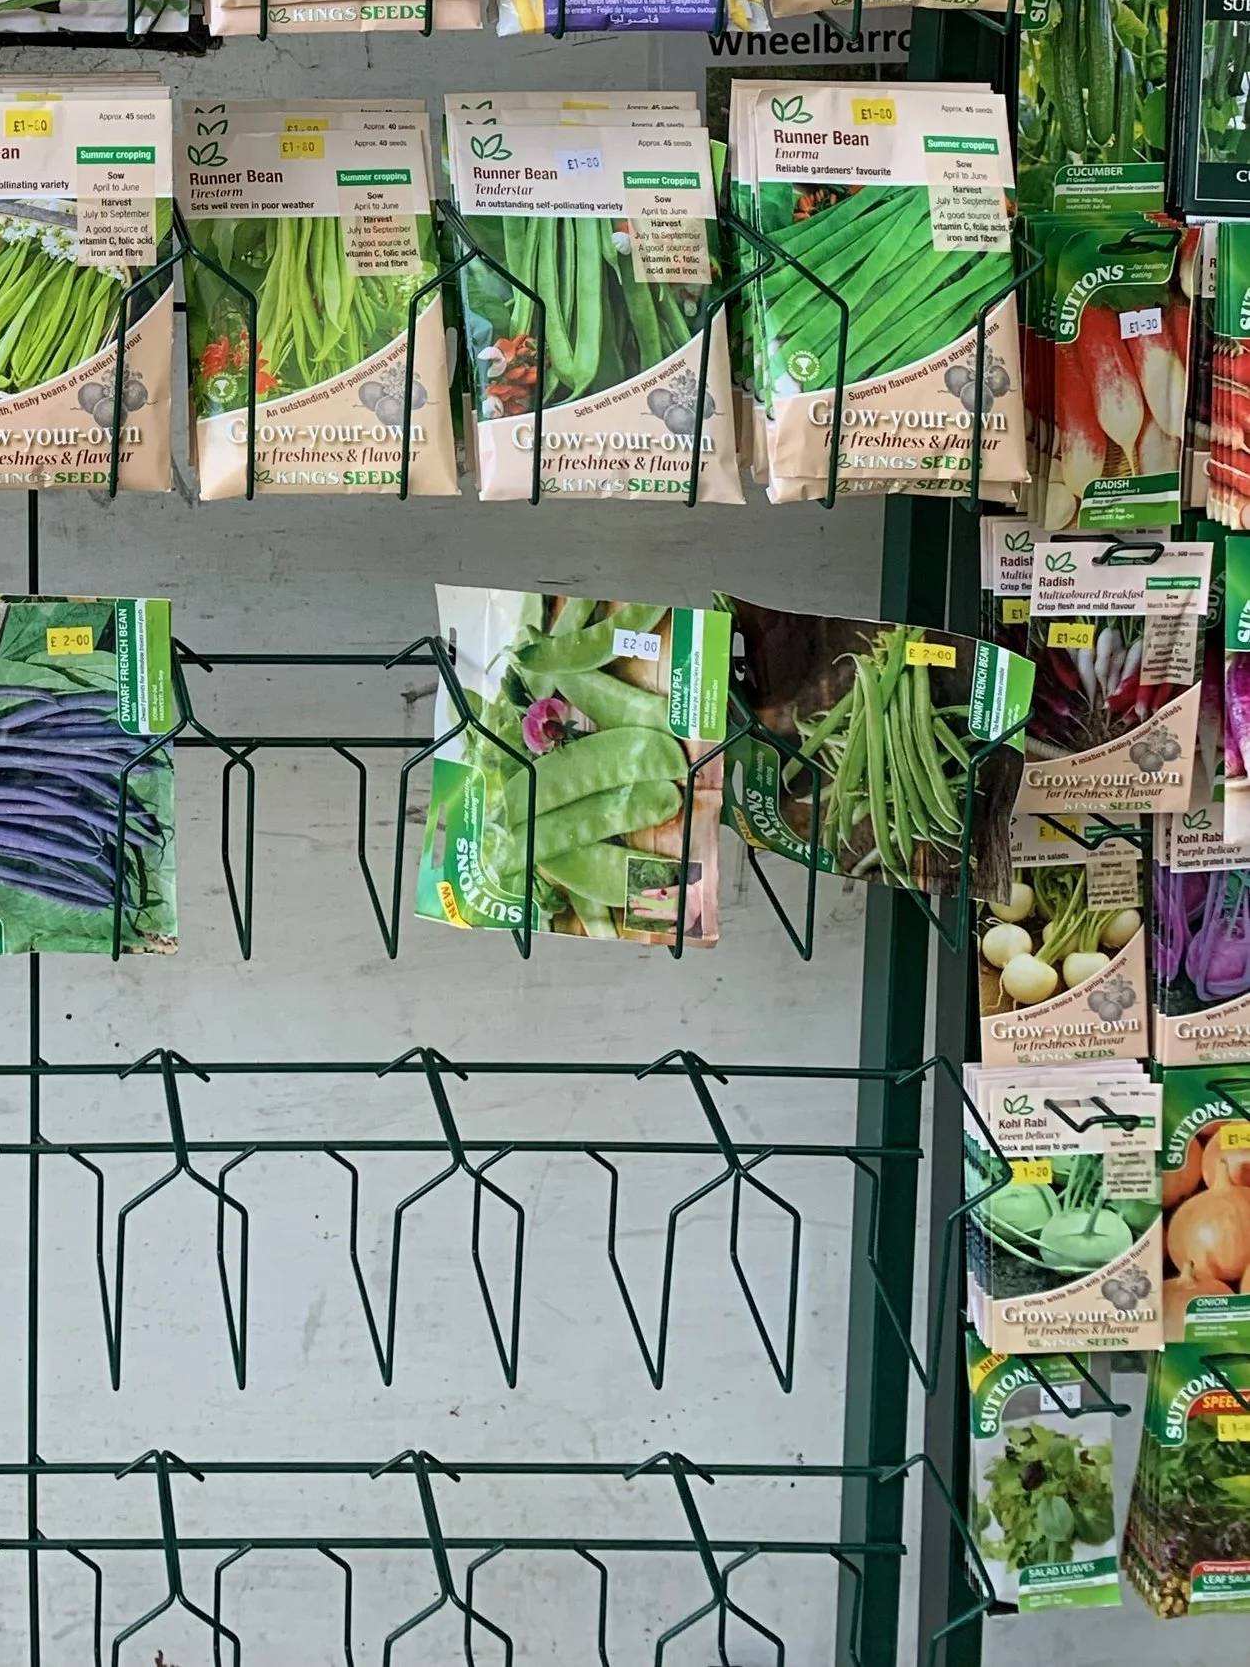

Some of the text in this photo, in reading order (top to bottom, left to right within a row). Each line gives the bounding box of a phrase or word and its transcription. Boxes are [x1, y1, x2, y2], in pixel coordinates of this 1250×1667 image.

[775, 148, 819, 160] Enorma
[1066, 167, 1123, 177] CUCUMBER
[191, 188, 243, 198] Firestorm
[476, 184, 534, 196] Tenderstar
[1129, 319, 1158, 333] £1-30
[1094, 479, 1130, 489] RADISH
[1039, 577, 1075, 586] Radish
[1038, 589, 1144, 600] Multicoloured Breakfast
[1056, 633, 1088, 644] £1-40
[118, 608, 131, 722] DWARF FRENCH BEAN
[670, 667, 683, 725] SNOW PEA
[1177, 834, 1200, 844] Kohl
[999, 1118, 1047, 1129] Kohl Rabi
[1196, 1298, 1228, 1306] ONION
[1028, 1563, 1095, 1577] SALAD LEAVES
